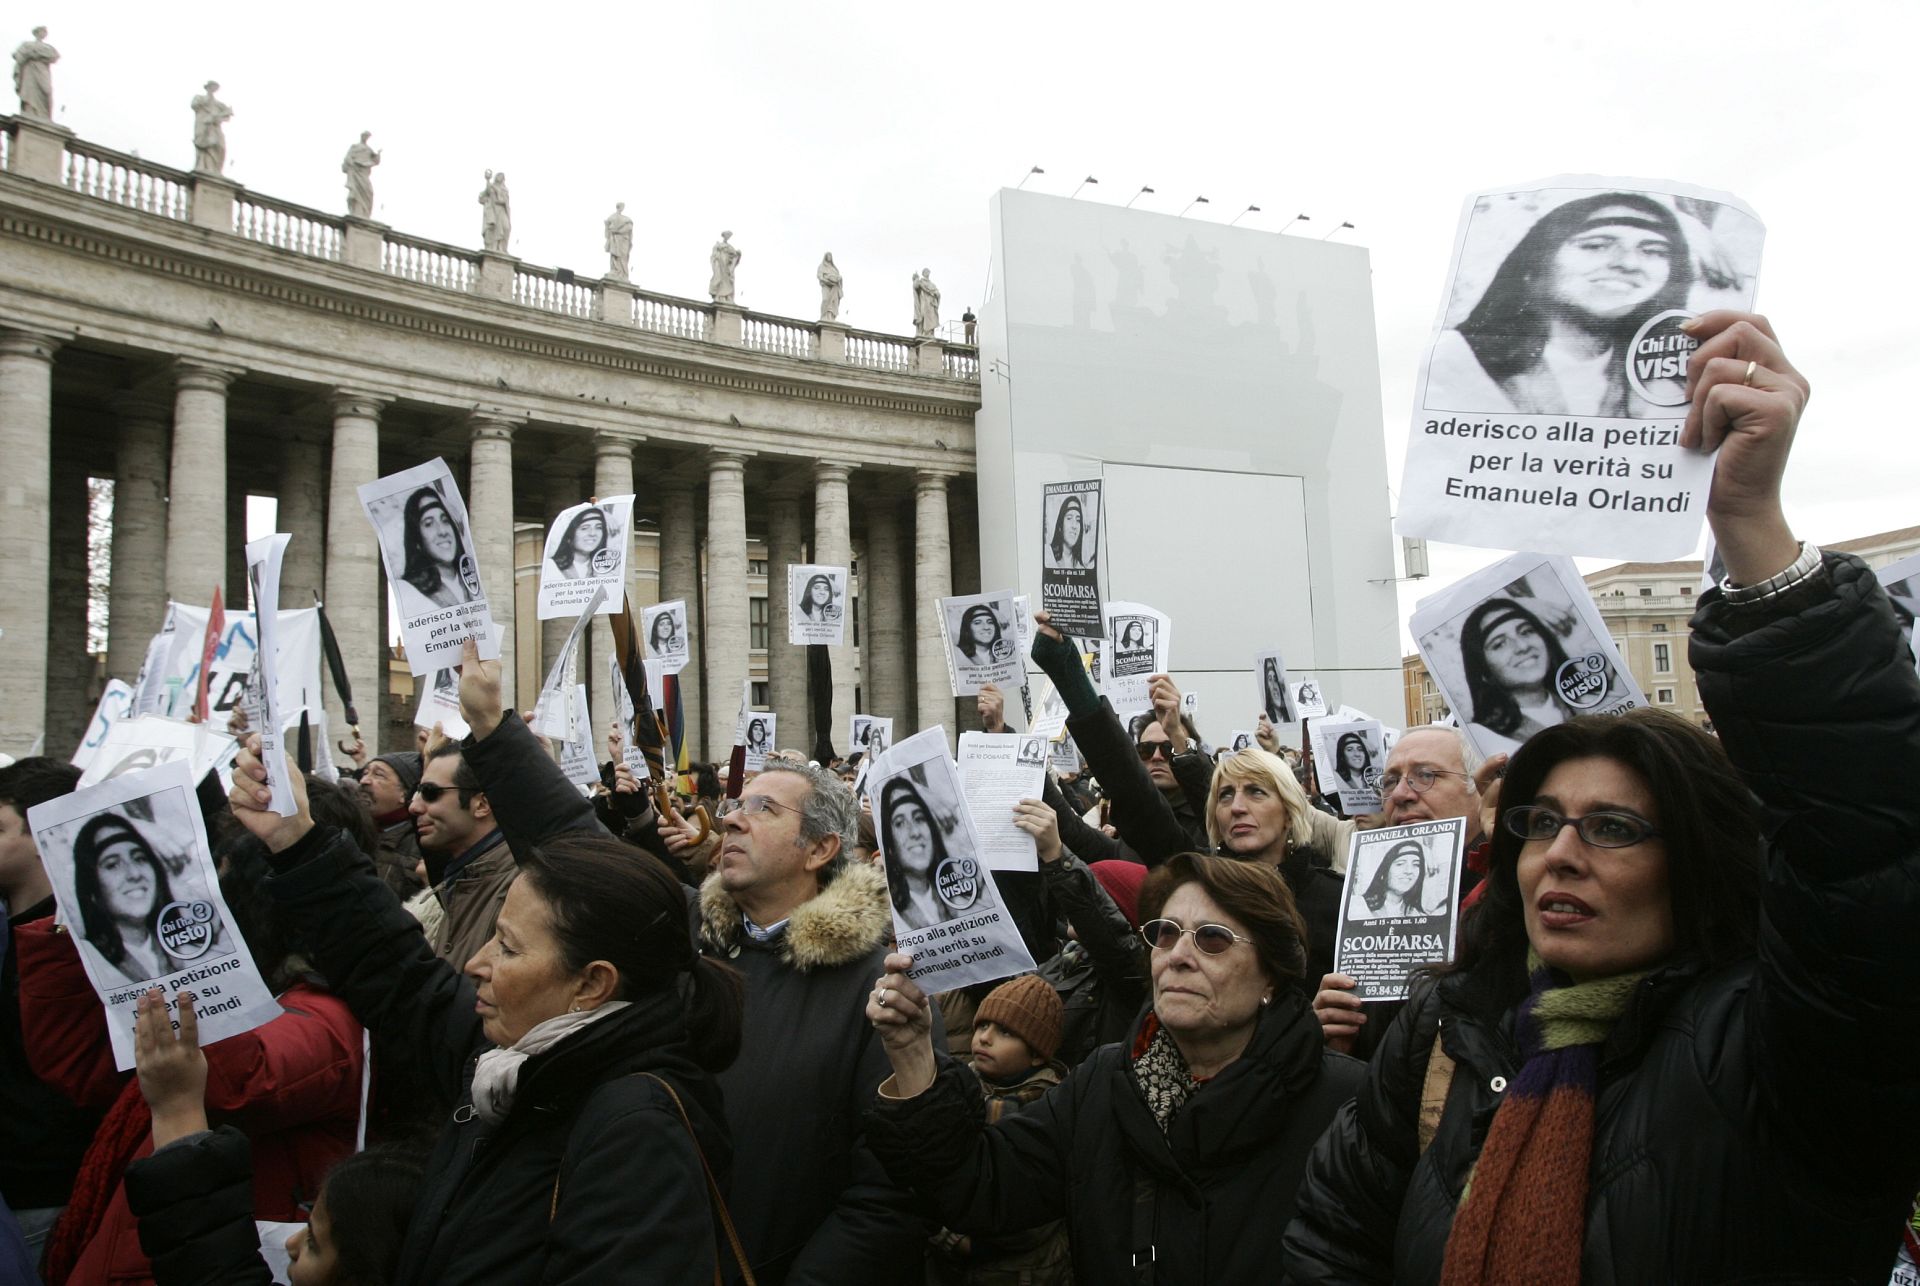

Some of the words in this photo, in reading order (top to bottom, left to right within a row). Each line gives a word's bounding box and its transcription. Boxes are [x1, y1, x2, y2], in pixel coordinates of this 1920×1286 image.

[1638, 338, 1665, 355] Chi
[1637, 353, 1690, 379] vist
[1425, 417, 1538, 441] aderisco
[1546, 421, 1595, 443] alla
[1604, 425, 1680, 448] petizi
[1469, 453, 1513, 473] per
[1521, 452, 1543, 473] la
[1553, 456, 1631, 478] verità
[1641, 462, 1673, 479] su
[1445, 477, 1578, 507] Emanuela
[1588, 488, 1691, 513] Orlandi
[543, 582, 571, 590] aderisco
[573, 579, 586, 587] alla
[587, 577, 619, 586] petizione
[1043, 583, 1097, 598] SCOMPARSA
[550, 597, 583, 606] Emanuela
[408, 610, 453, 629] aderisco
[430, 626, 447, 639] per
[450, 623, 461, 632] la
[1560, 676, 1574, 690] Chi
[1116, 695, 1149, 705] EMANUE
[1360, 830, 1409, 844] EMANUELA
[1411, 822, 1457, 836] ORLANDI
[939, 874, 950, 886] Chi
[942, 879, 972, 899] visto
[161, 922, 176, 934] Chi
[165, 925, 205, 947] visto
[897, 933, 925, 949] erisco
[925, 926, 946, 941] alla
[948, 913, 999, 936] petizione
[926, 948, 937, 959] la
[939, 938, 970, 955] verità
[971, 935, 986, 947] su
[1342, 933, 1444, 953] SCOMPARSA
[906, 960, 962, 981] Emanuela
[961, 946, 1005, 965] Orlandi
[169, 958, 241, 991] petizione
[201, 984, 222, 998] su
[196, 995, 242, 1020] rlandi
